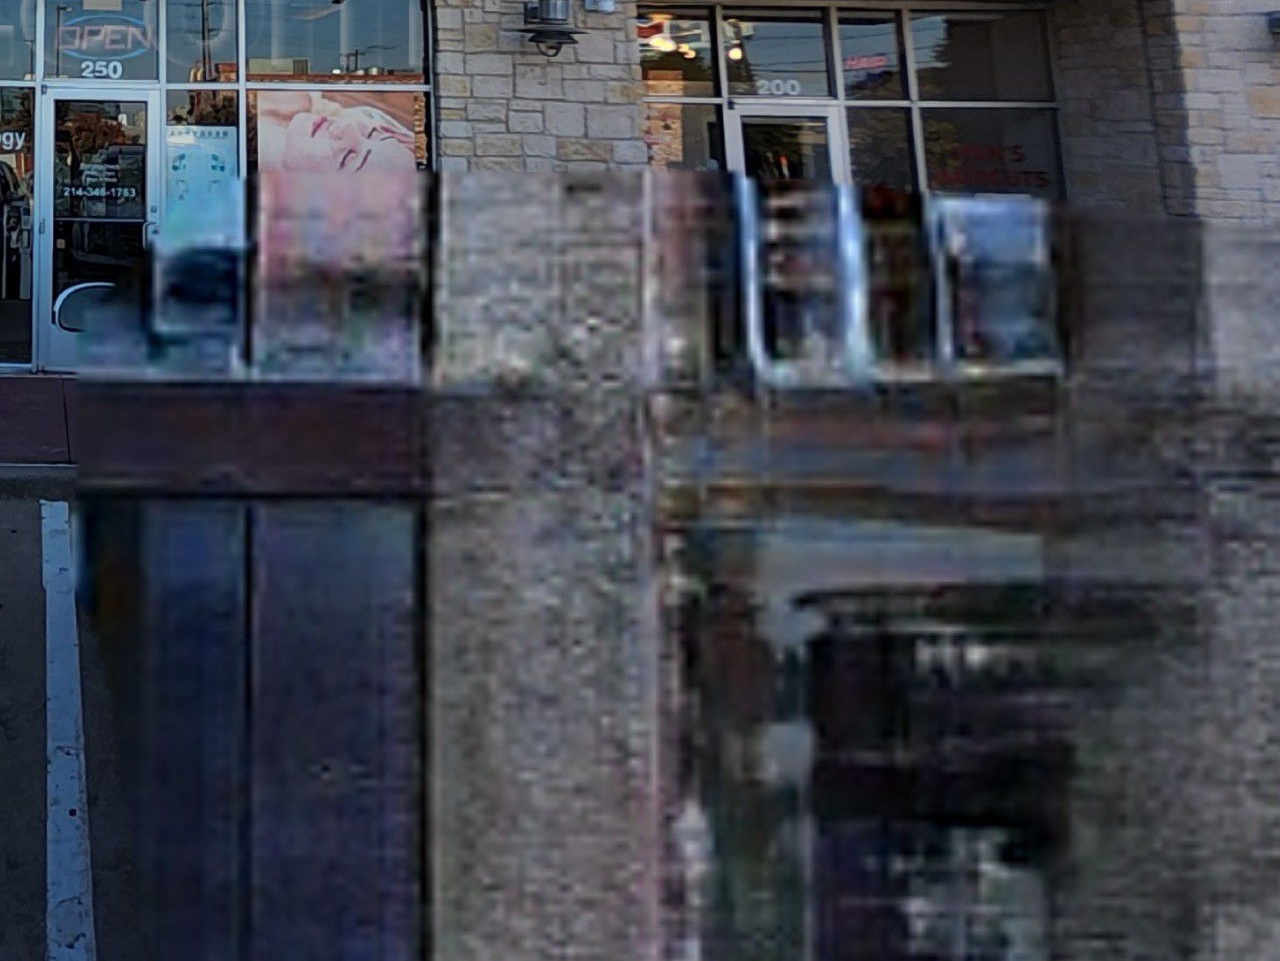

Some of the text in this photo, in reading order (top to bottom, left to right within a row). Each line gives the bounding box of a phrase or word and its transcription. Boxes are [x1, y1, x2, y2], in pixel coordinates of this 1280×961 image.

[55, 24, 153, 51] OPEN
[81, 60, 123, 79] 250
[755, 79, 801, 95] 200
